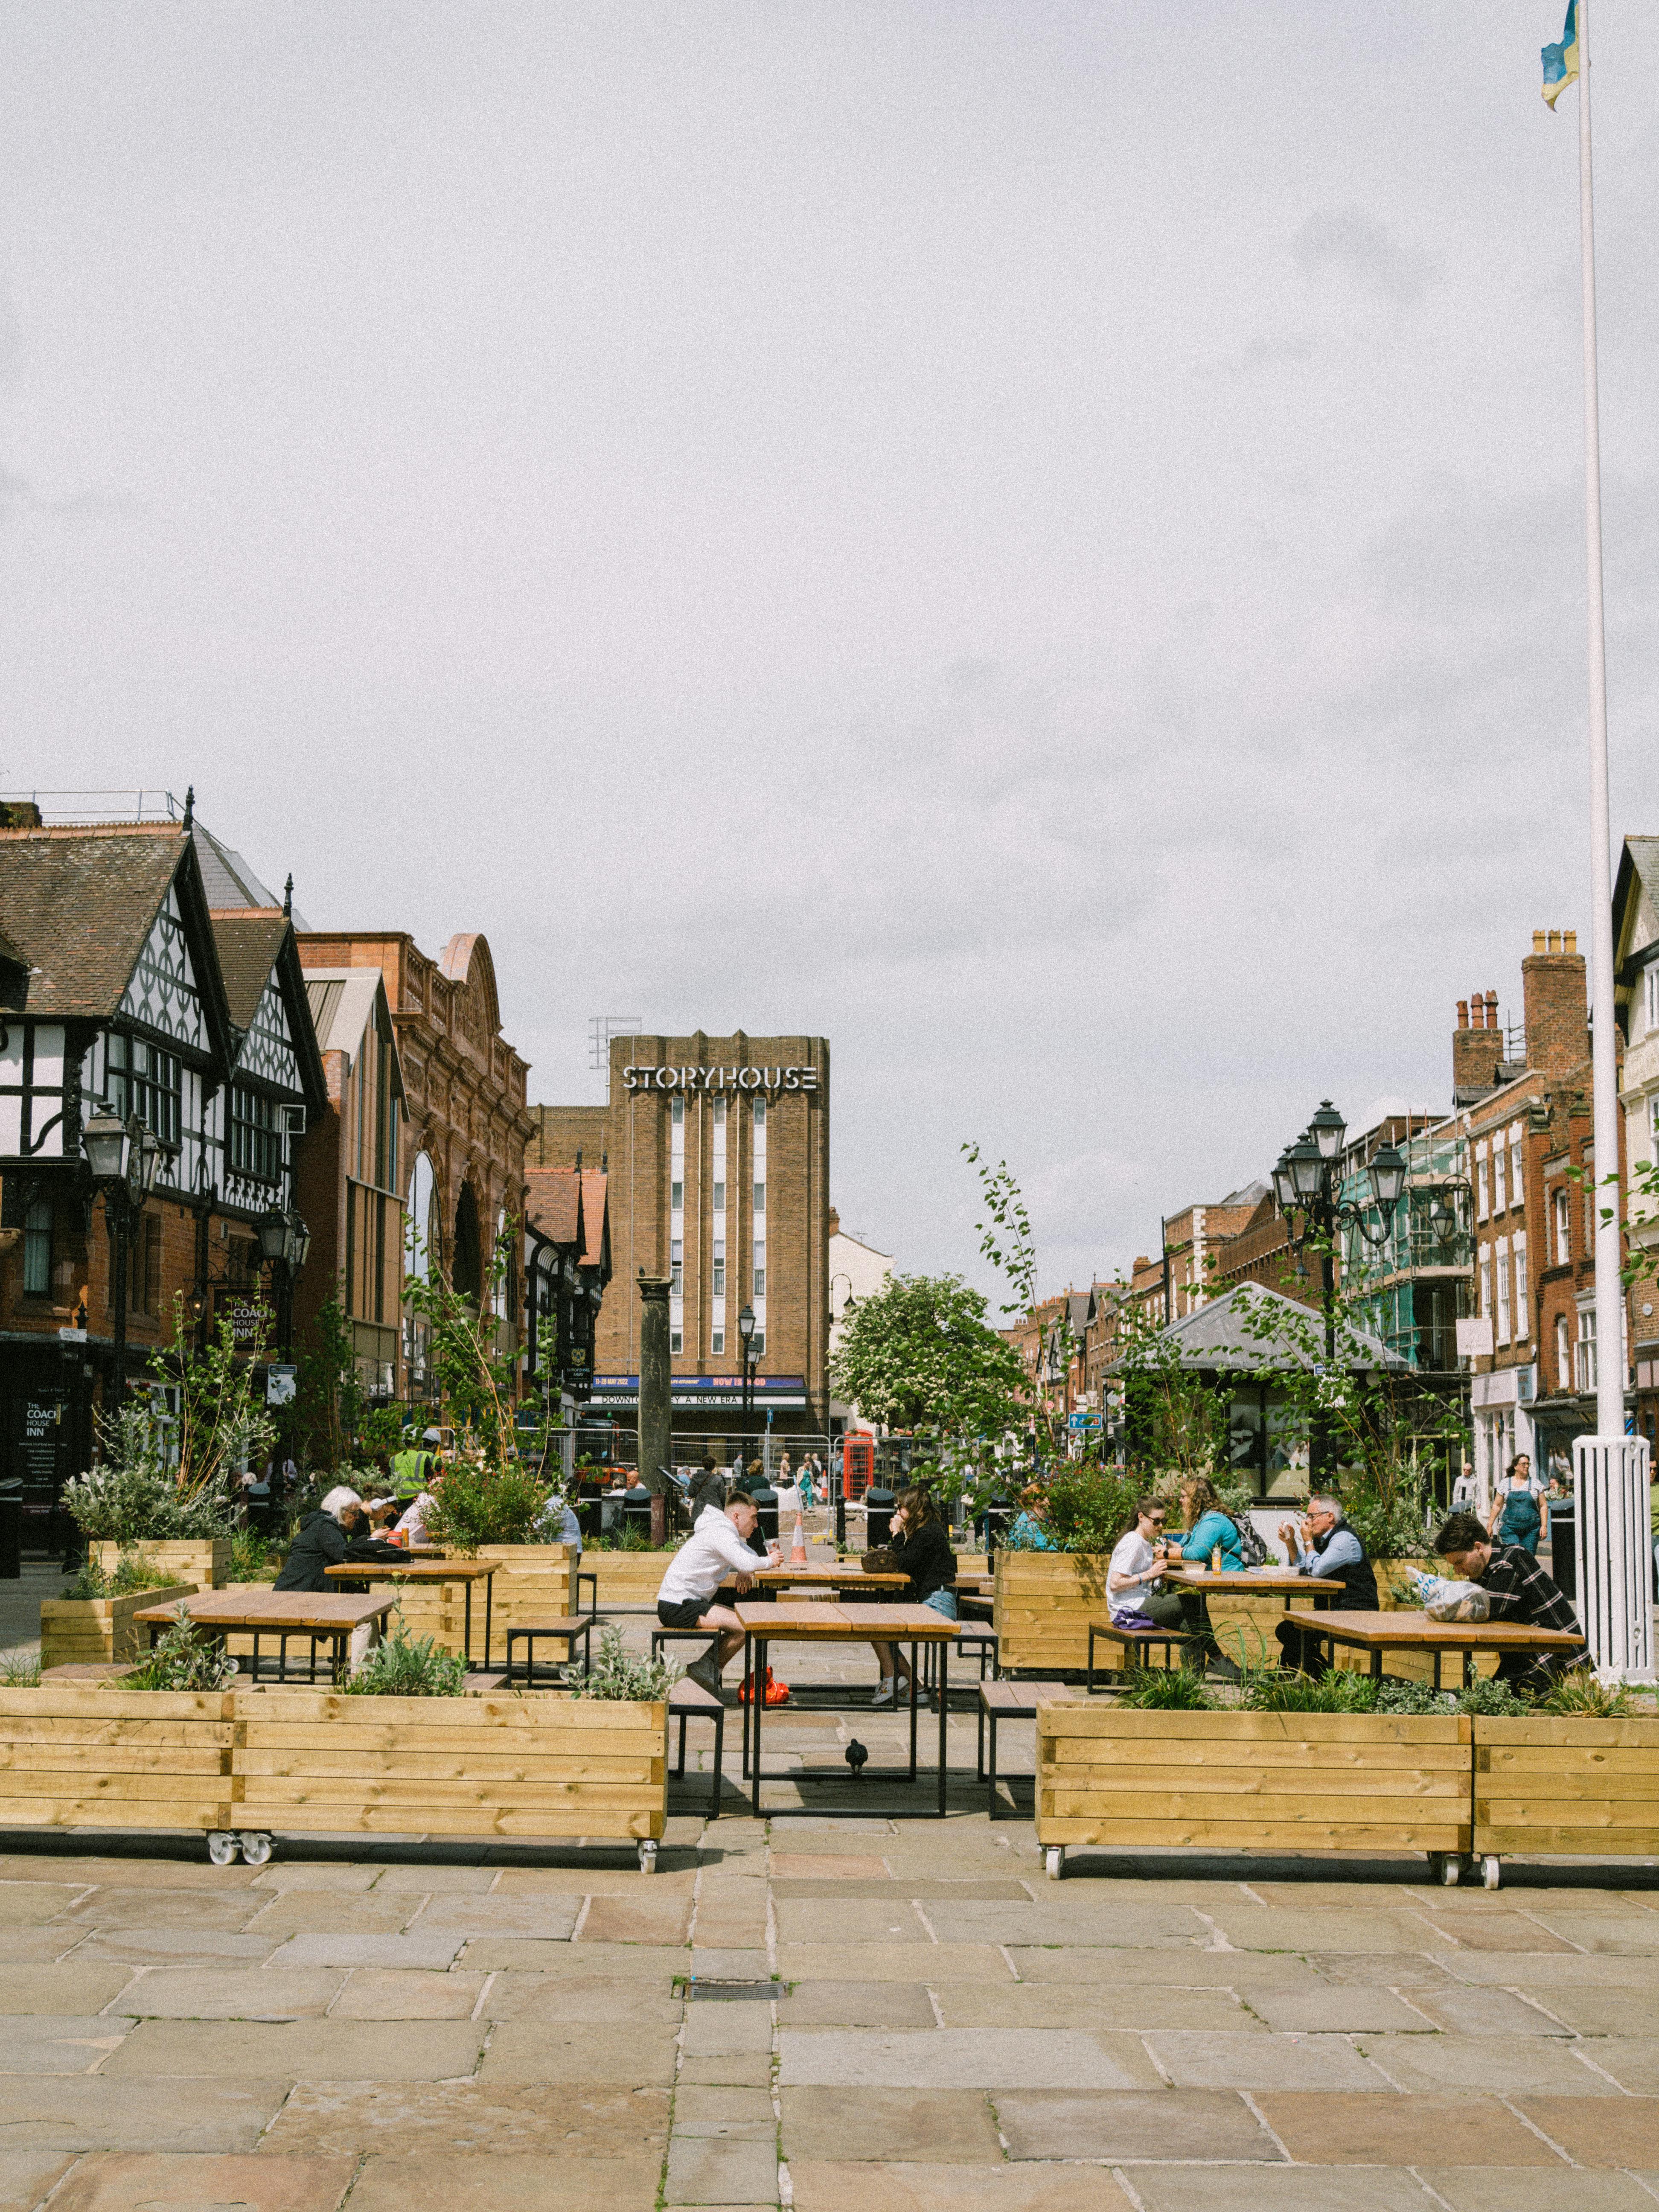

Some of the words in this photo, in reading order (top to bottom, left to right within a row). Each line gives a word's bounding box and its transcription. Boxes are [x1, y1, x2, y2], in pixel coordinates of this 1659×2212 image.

[623, 1066, 816, 1088] STORYHOUSE
[233, 1328, 253, 1337] INN
[26, 1428, 44, 1436] INN
